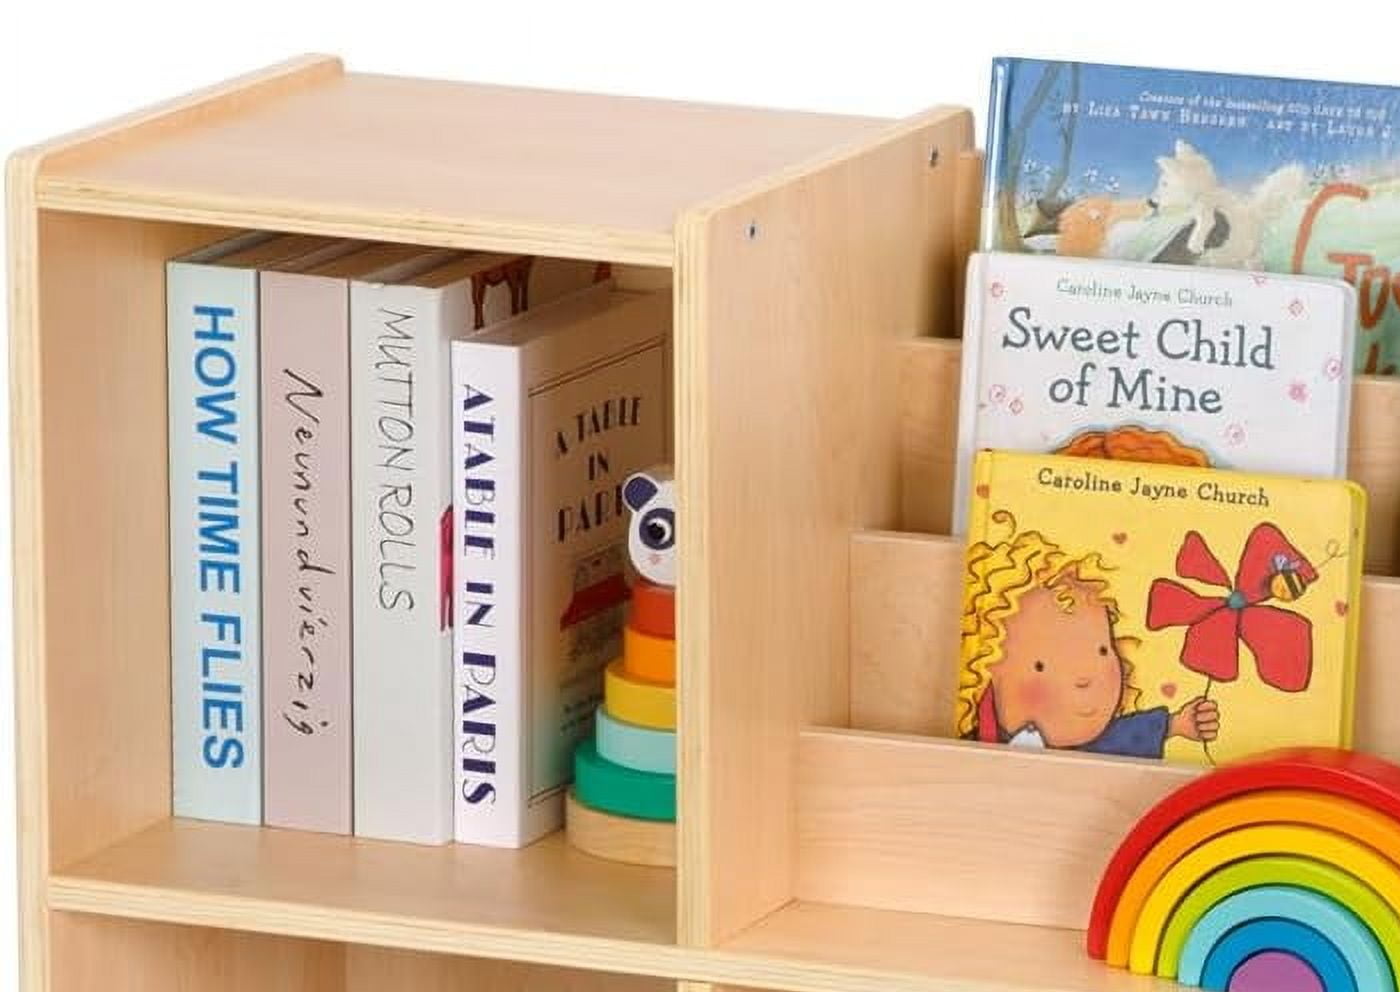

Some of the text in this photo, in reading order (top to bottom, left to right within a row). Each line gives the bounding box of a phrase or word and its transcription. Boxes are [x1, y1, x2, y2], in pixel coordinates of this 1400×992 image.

[1056, 277, 1233, 307] Caroline Jayne Church
[1002, 306, 1276, 371] Sweet Child
[1048, 362, 1224, 414] of Mine
[375, 306, 416, 611] MUTTON ROLLS
[555, 430, 569, 456] A
[588, 452, 610, 482] IN
[557, 483, 624, 543] PARI
[1037, 467, 1270, 508] Caroline Jayne Church
[193, 304, 245, 770] HOW TIME FLIES
[465, 581, 496, 629] IN
[463, 650, 497, 806] PARIS
